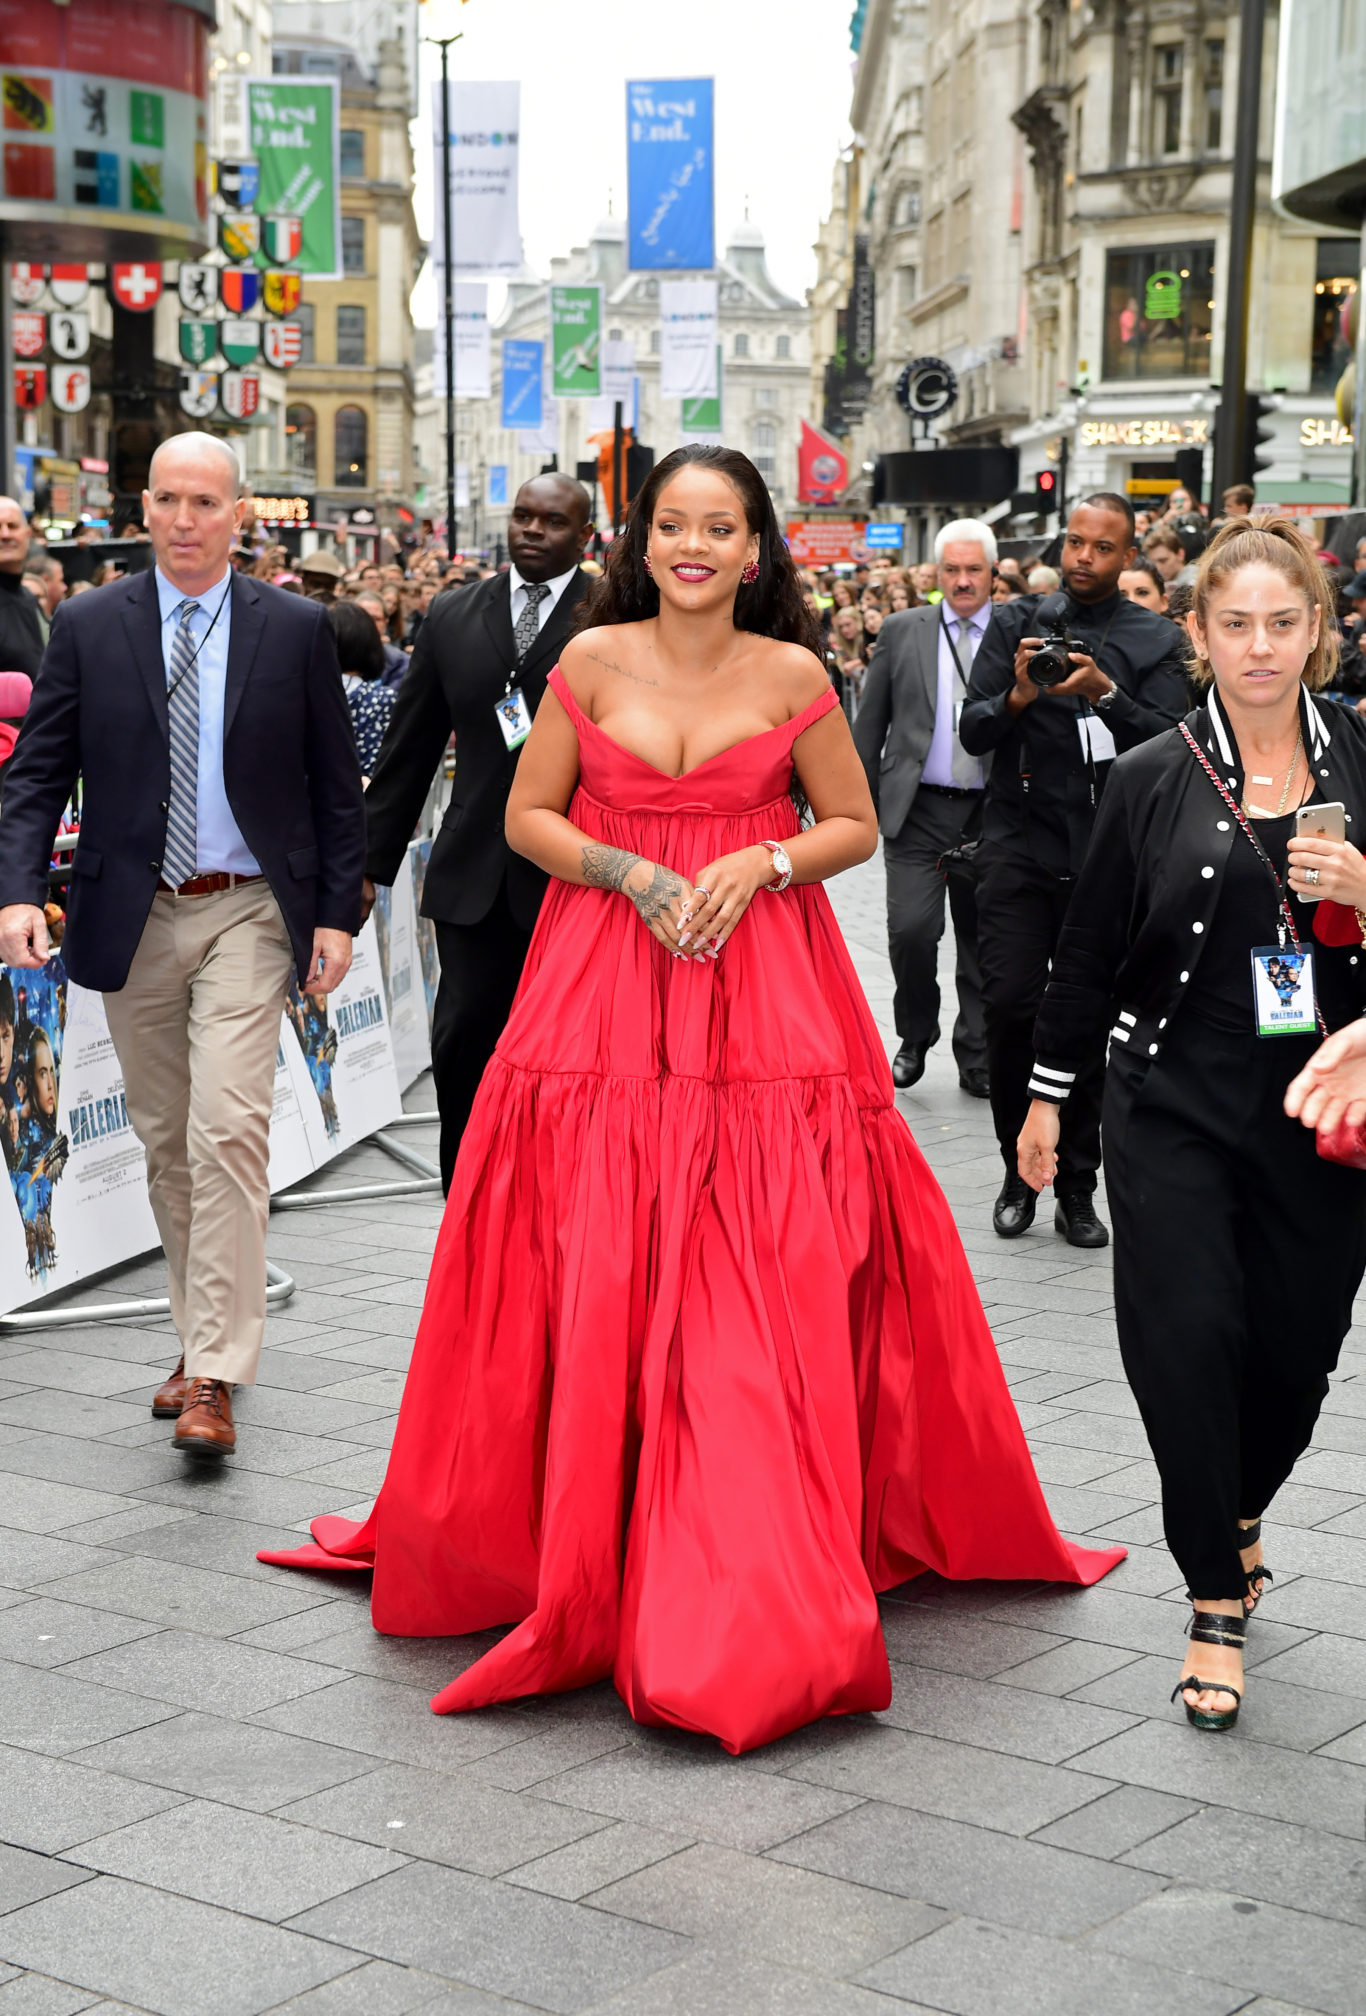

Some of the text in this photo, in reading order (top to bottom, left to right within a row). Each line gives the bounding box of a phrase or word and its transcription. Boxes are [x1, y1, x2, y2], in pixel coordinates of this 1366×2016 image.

[252, 101, 318, 125] West
[631, 98, 697, 118] West
[252, 125, 312, 148] End.
[631, 118, 691, 142] End.
[1080, 419, 1208, 447] SHAKE SHACK
[335, 994, 383, 1038] VALERIAN
[69, 1093, 132, 1146] VALERIA
